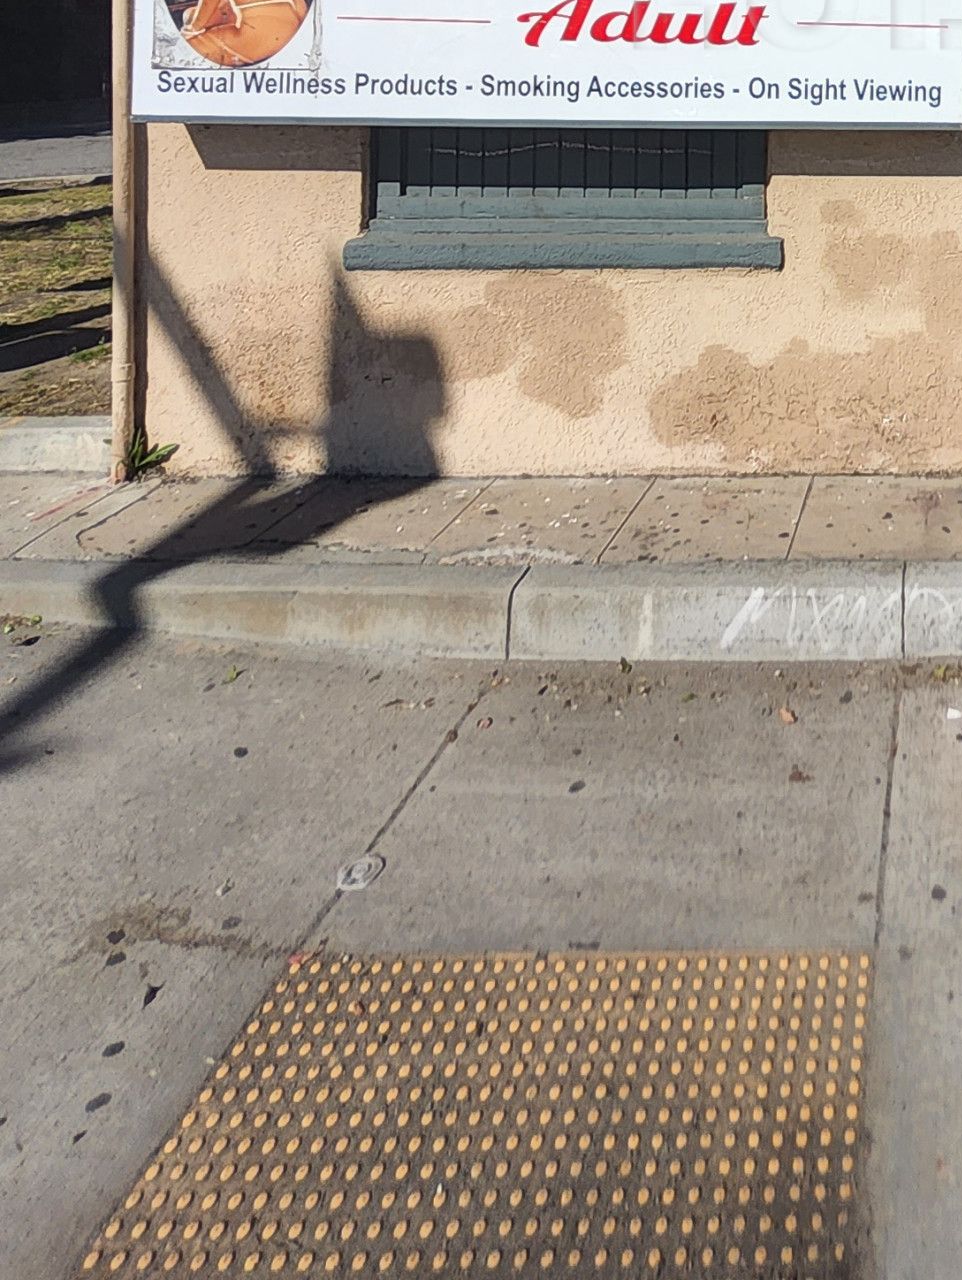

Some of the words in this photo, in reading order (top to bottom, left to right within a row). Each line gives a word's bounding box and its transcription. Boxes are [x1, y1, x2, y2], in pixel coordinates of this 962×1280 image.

[157, 70, 235, 93] Sexual
[243, 71, 346, 94] Wellness
[355, 74, 457, 96] Products
[480, 75, 580, 103] Smoking
[587, 76, 724, 99] Accessories
[749, 78, 779, 100] On
[788, 78, 846, 105] Sight
[854, 79, 941, 107] Viewing
